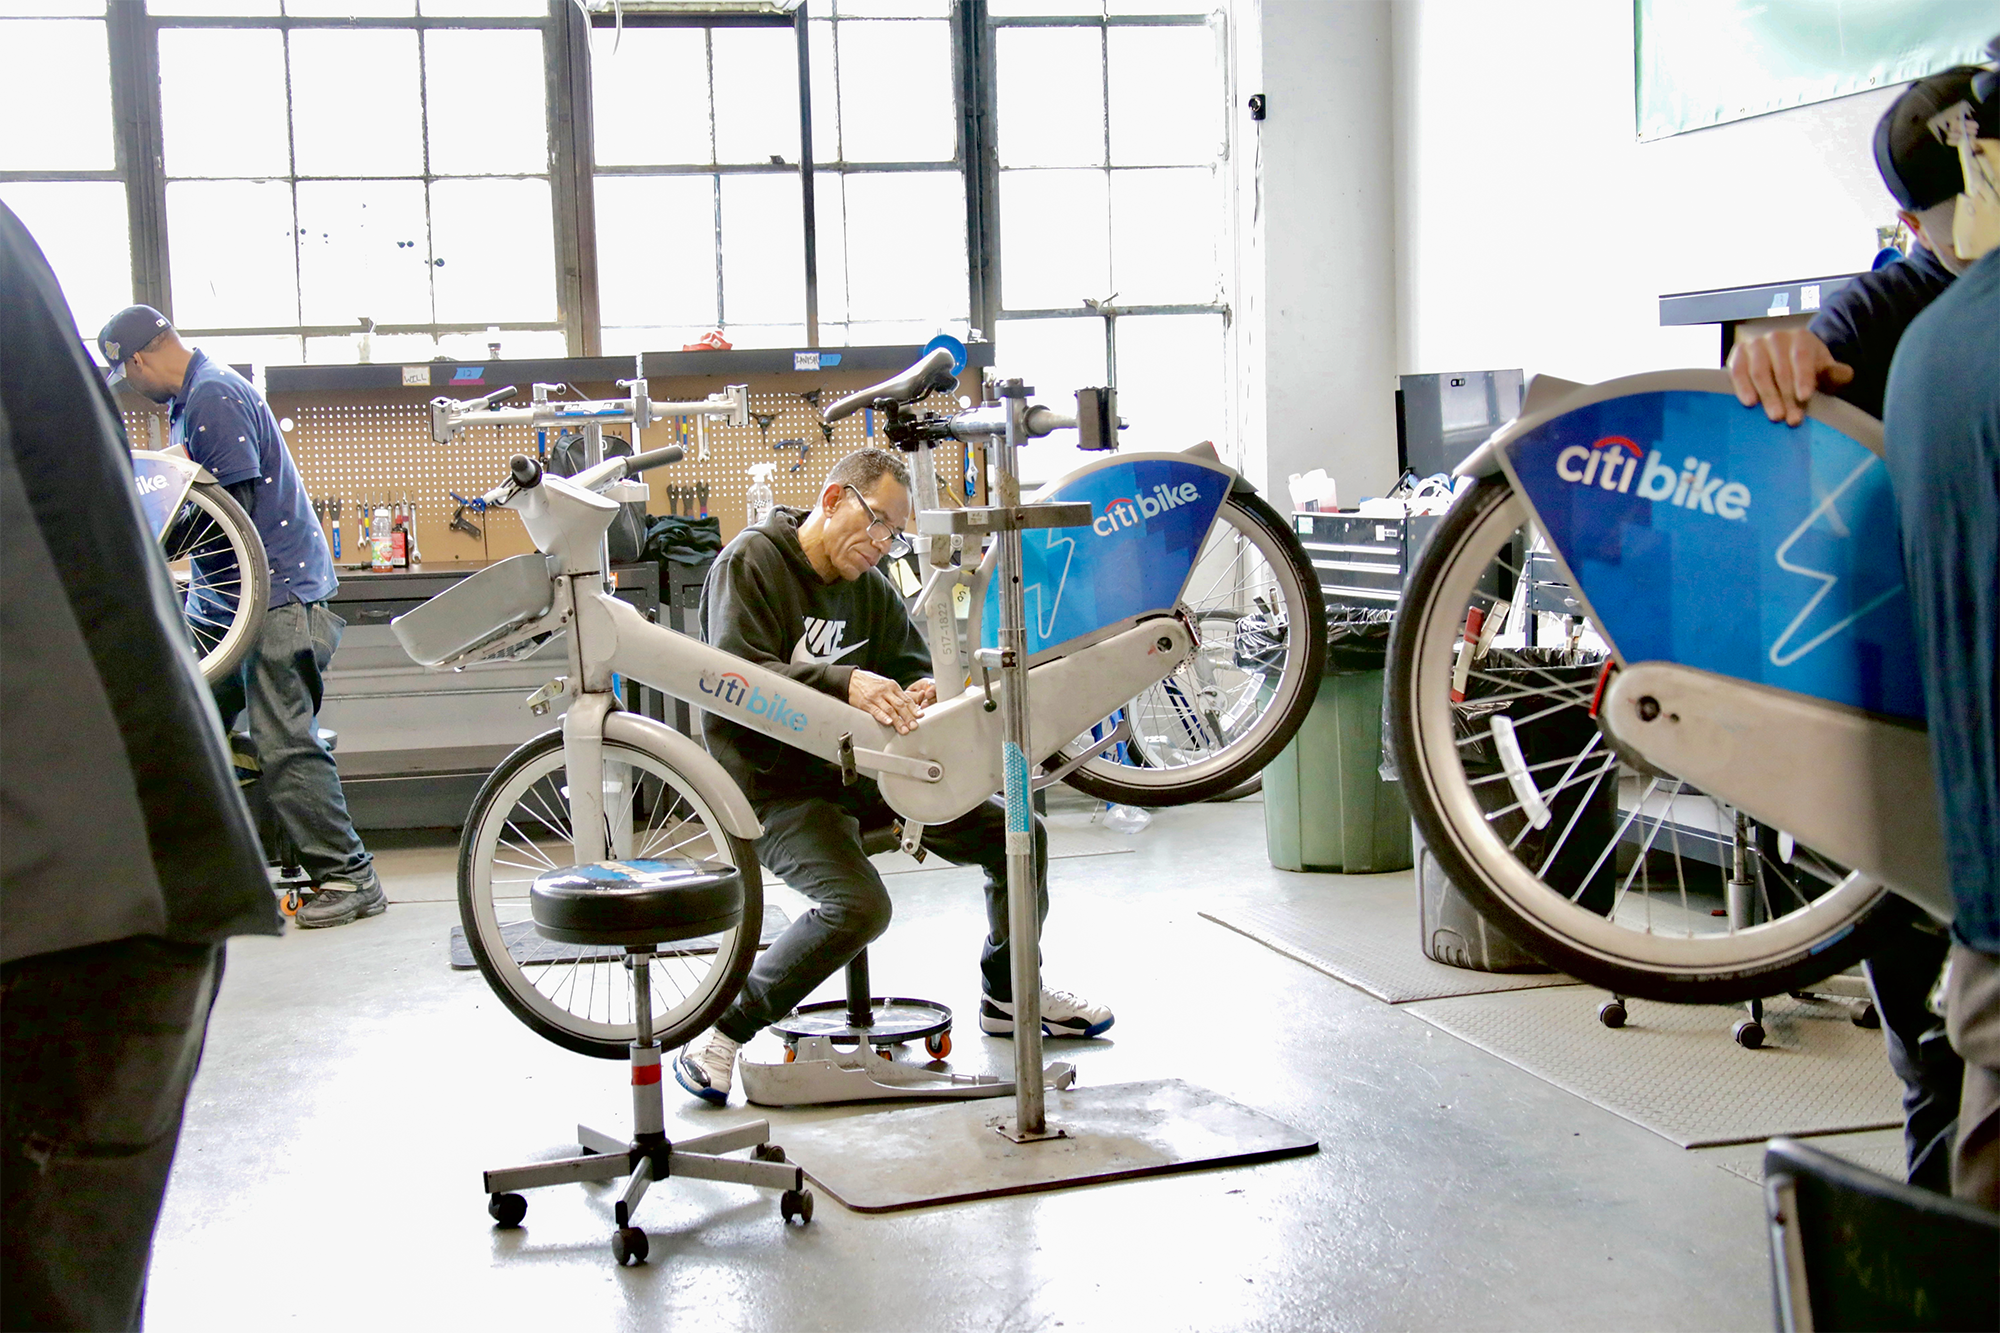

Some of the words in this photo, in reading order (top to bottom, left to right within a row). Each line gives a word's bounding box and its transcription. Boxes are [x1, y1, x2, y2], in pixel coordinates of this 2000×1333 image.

[404, 373, 427, 383] WILL
[463, 369, 473, 377] 12
[135, 474, 168, 496] ike
[1556, 443, 1638, 494] citi
[1636, 450, 1751, 520] bike
[1093, 502, 1139, 537] citi
[1134, 482, 1199, 519] bike
[803, 616, 847, 655] NIKE
[937, 602, 953, 655] 517-1822
[699, 677, 746, 707] citi
[746, 686, 808, 732] bike
